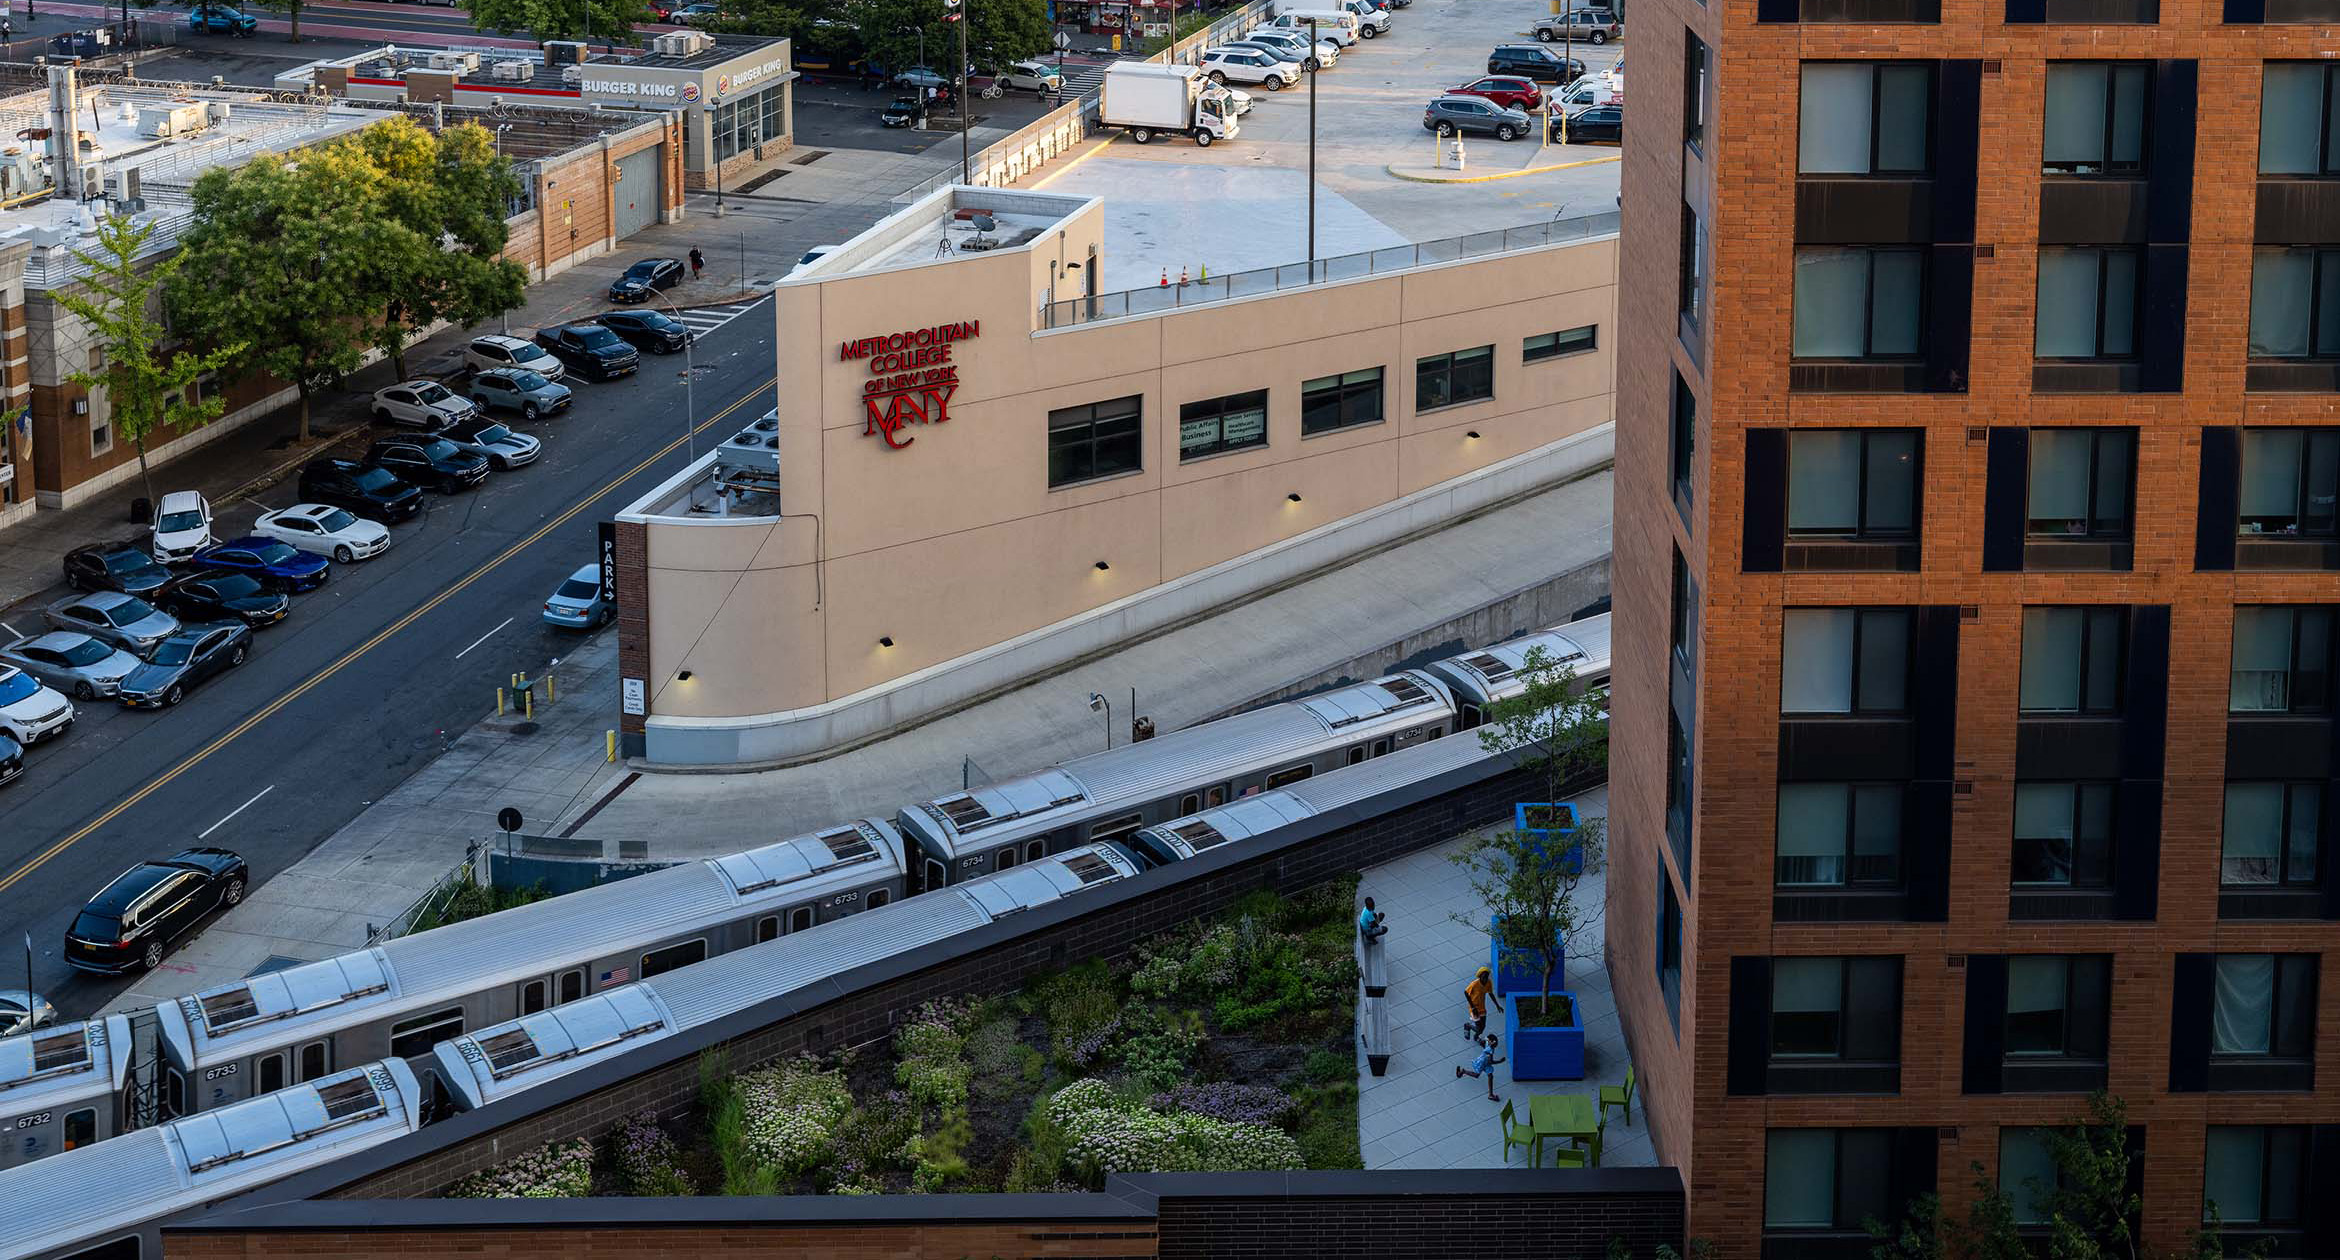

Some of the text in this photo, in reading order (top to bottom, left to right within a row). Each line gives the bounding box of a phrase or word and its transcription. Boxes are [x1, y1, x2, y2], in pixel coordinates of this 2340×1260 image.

[732, 67, 762, 86] BURGER
[763, 60, 782, 74] KING
[581, 80, 676, 97] BURGER KING
[841, 320, 979, 361] METROPOLITAN
[870, 344, 952, 375] COLLEGE
[865, 365, 958, 393] OF NEW YORK
[1181, 430, 1212, 441] Business
[604, 541, 614, 589] PARK
[1405, 728, 1422, 739] 6734
[962, 855, 984, 868] 6734
[1100, 847, 1122, 864] 6661
[834, 892, 858, 905] 6733
[181, 999, 201, 1023] 6733
[89, 1024, 105, 1047] 6732
[460, 1042, 482, 1064] 6661
[206, 1064, 238, 1081] 6733
[371, 1066, 396, 1091] 6662
[17, 1113, 50, 1130] 6732
